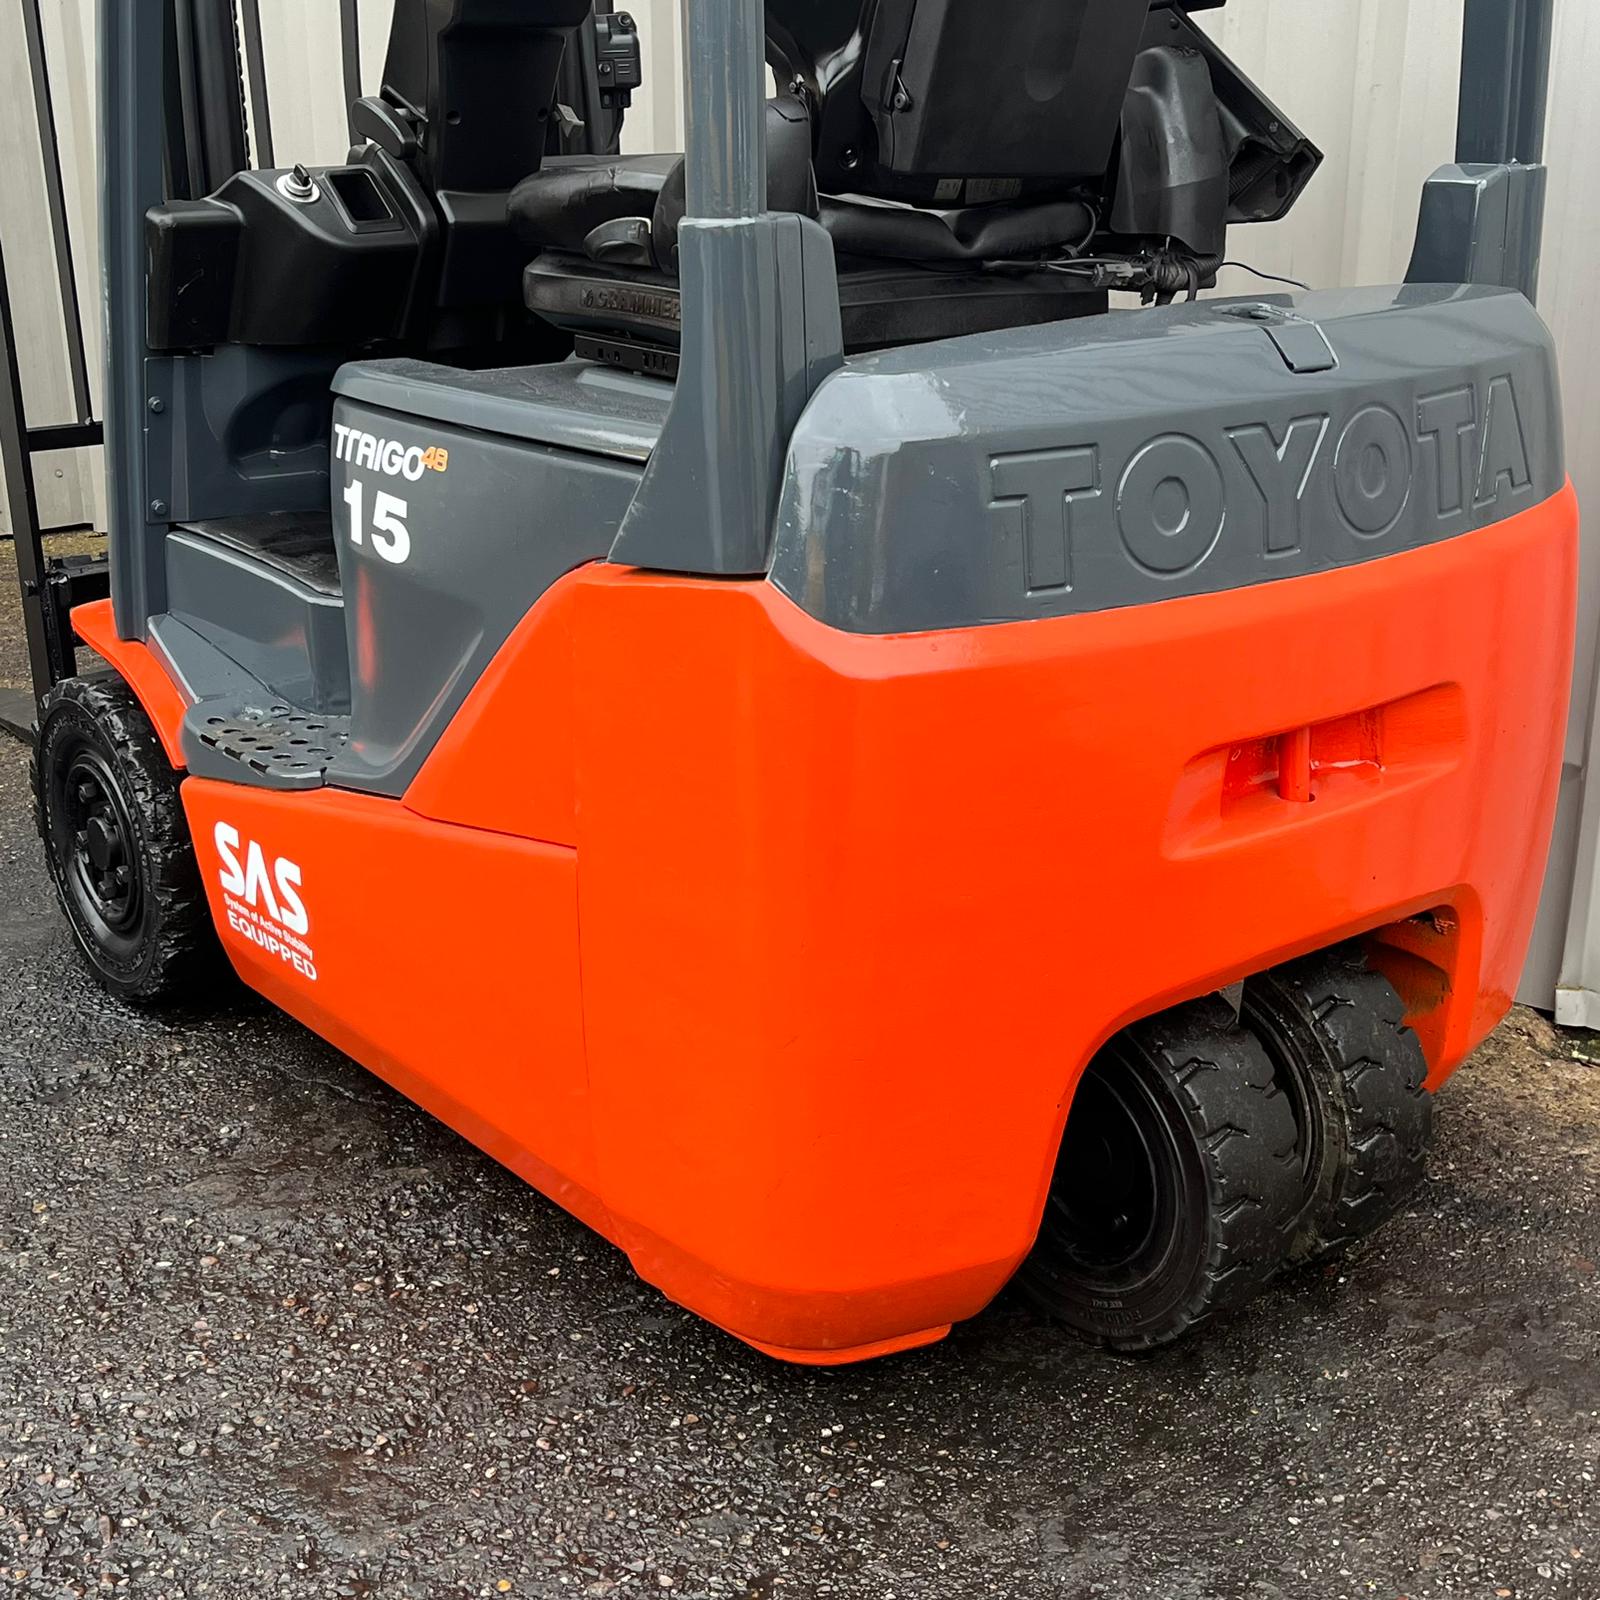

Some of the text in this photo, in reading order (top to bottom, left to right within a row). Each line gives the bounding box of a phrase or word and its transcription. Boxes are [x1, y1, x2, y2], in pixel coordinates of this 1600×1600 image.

[343, 479, 411, 564] 15
[987, 373, 1533, 598] TOYOTA
[214, 821, 309, 935] SAS
[227, 908, 318, 981] EQUIPPED
